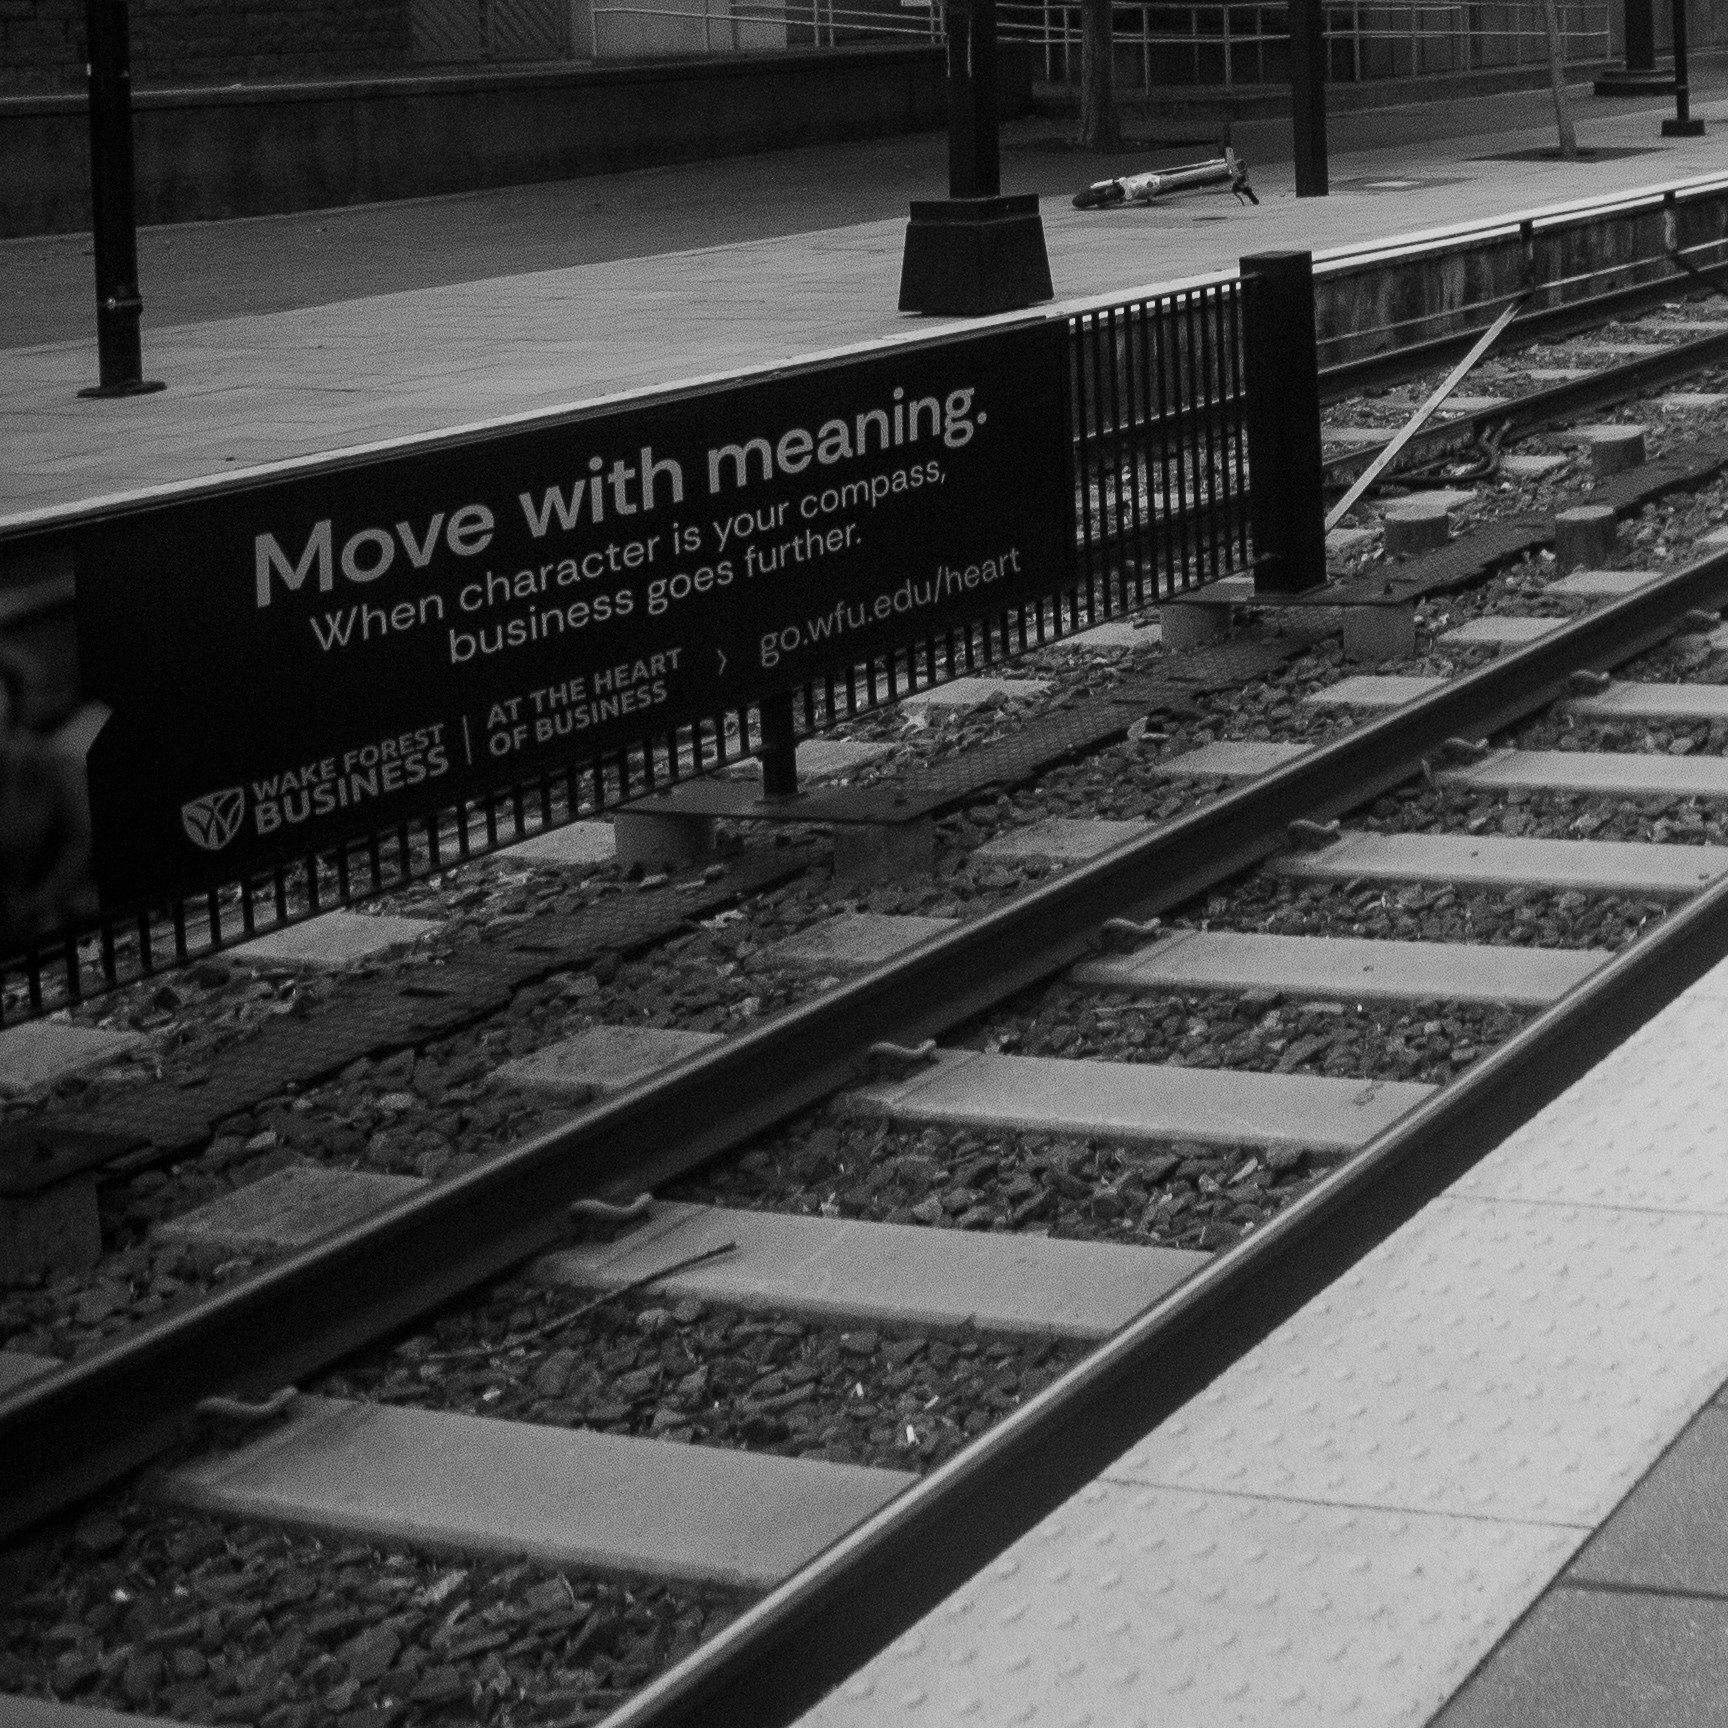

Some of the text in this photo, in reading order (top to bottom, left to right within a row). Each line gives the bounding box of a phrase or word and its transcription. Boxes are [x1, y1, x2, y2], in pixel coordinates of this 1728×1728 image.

[254, 386, 988, 609] Move with meaning.
[309, 460, 947, 652] When character is your compass,
[448, 519, 862, 665] business goes further.
[759, 546, 1022, 668] go.wfu.edu/heart
[487, 647, 684, 729] AT THE HEART
[488, 679, 669, 757] OF BUSINESS
[251, 722, 445, 803] WAKE FOREST
[253, 744, 450, 836] BUSINESS
